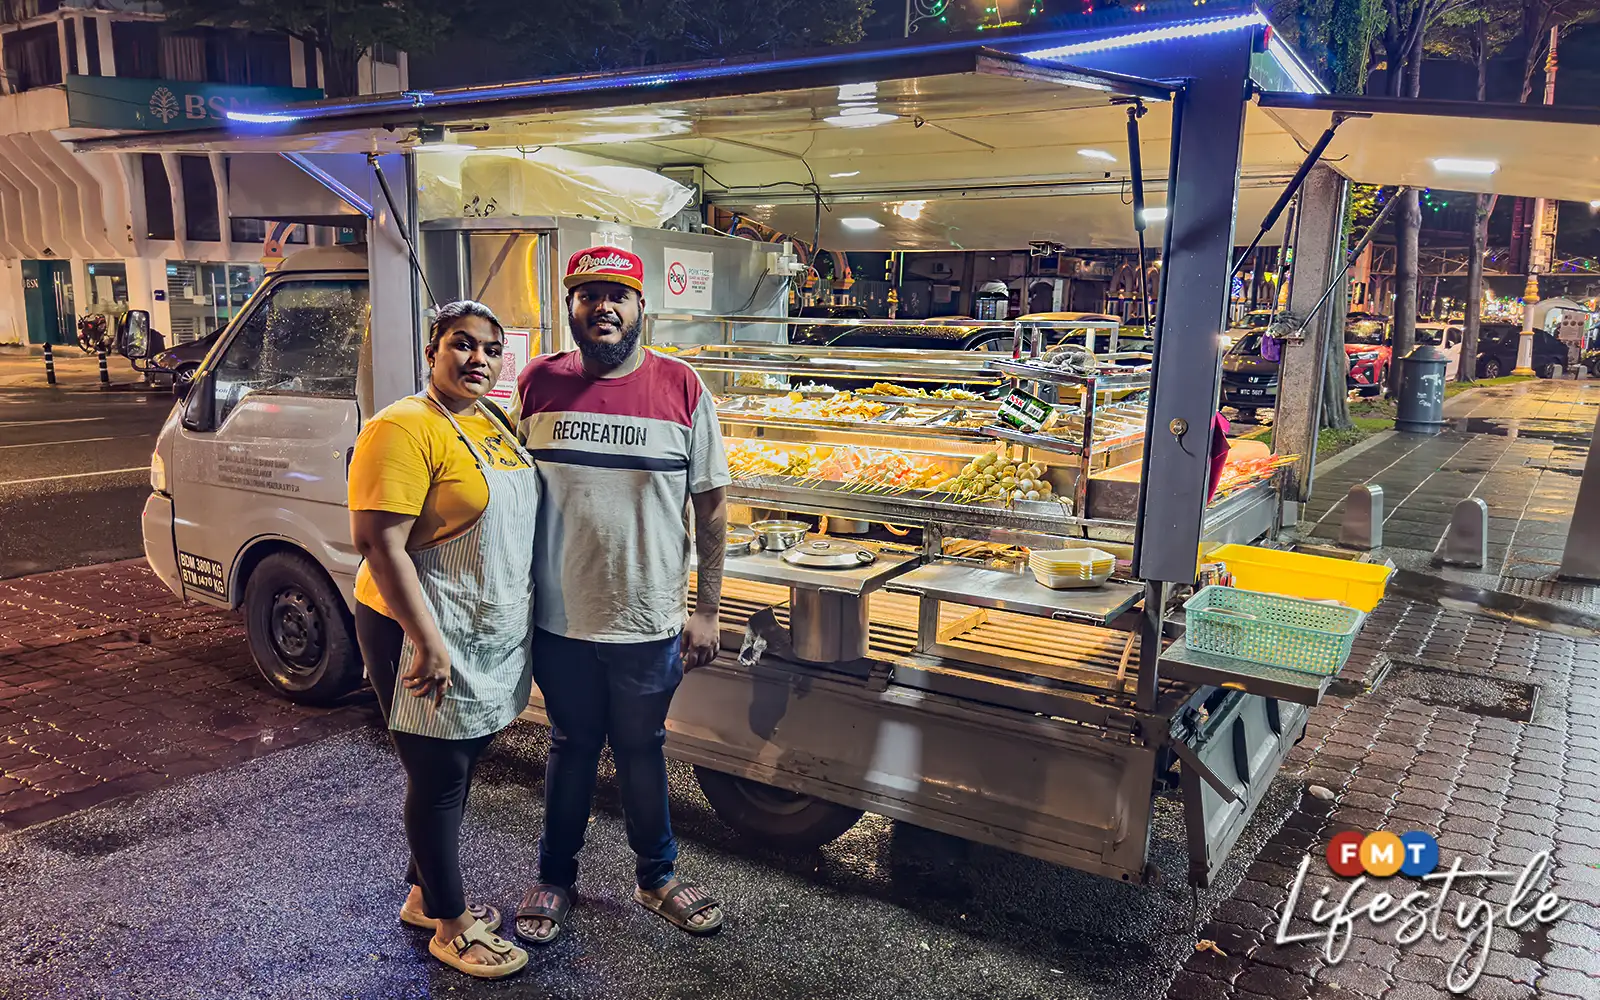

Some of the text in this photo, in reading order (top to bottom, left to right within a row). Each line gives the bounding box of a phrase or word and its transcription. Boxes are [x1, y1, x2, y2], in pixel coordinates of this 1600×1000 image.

[574, 252, 634, 274] Brooklyn
[552, 420, 648, 446] RECREATION
[180, 553, 196, 569] BDM
[211, 562, 222, 578] KG
[182, 568, 225, 594] BTM 1470 KG
